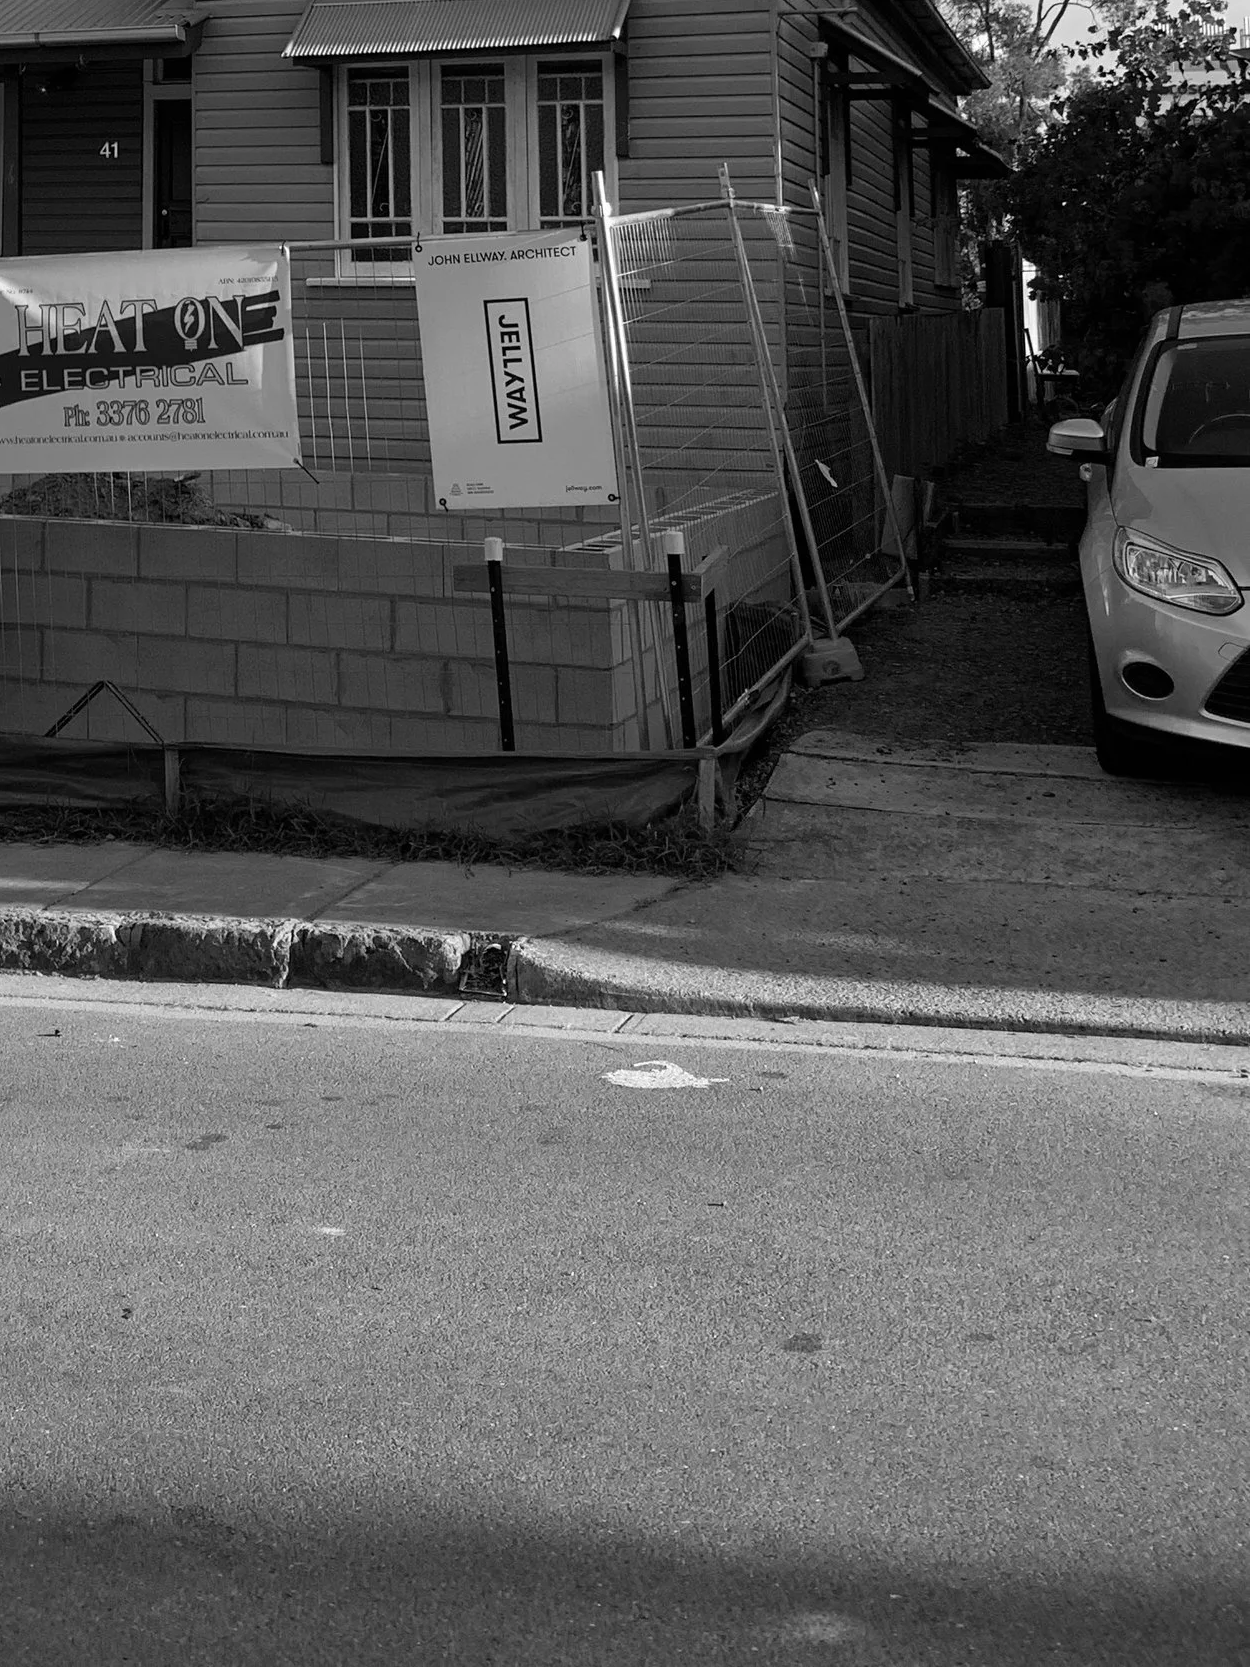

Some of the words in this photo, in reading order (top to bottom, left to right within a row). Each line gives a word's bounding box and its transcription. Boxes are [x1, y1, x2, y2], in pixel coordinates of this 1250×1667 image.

[99, 141, 118, 159] 41
[428, 253, 461, 266] JOHN
[510, 245, 577, 261] ARCHITECT
[15, 298, 158, 357] HEAT
[174, 294, 247, 352] ON
[20, 362, 249, 392] ELECTRICAL
[63, 403, 90, 427] Ph:
[96, 399, 151, 427] 3376
[155, 397, 206, 425] 2781
